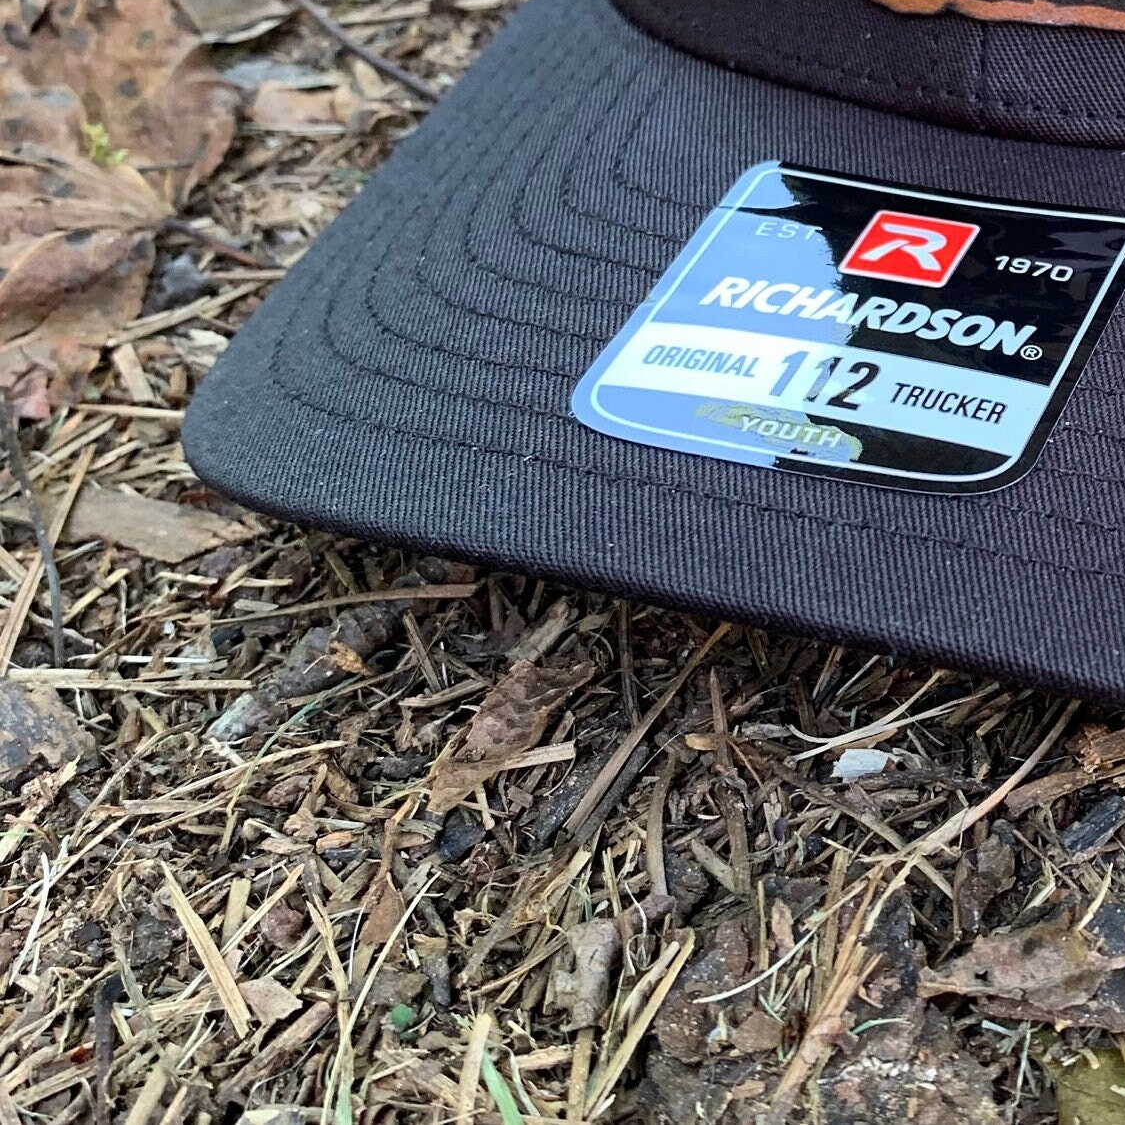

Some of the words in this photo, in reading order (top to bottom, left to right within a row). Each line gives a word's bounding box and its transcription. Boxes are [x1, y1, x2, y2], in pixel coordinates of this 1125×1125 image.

[858, 222, 947, 272] R
[994, 254, 1075, 283] 1970
[642, 344, 756, 378] ORIGINAL
[768, 350, 881, 411] 112
[889, 381, 1007, 425] TRUCKER
[739, 414, 843, 449] YOUTH
